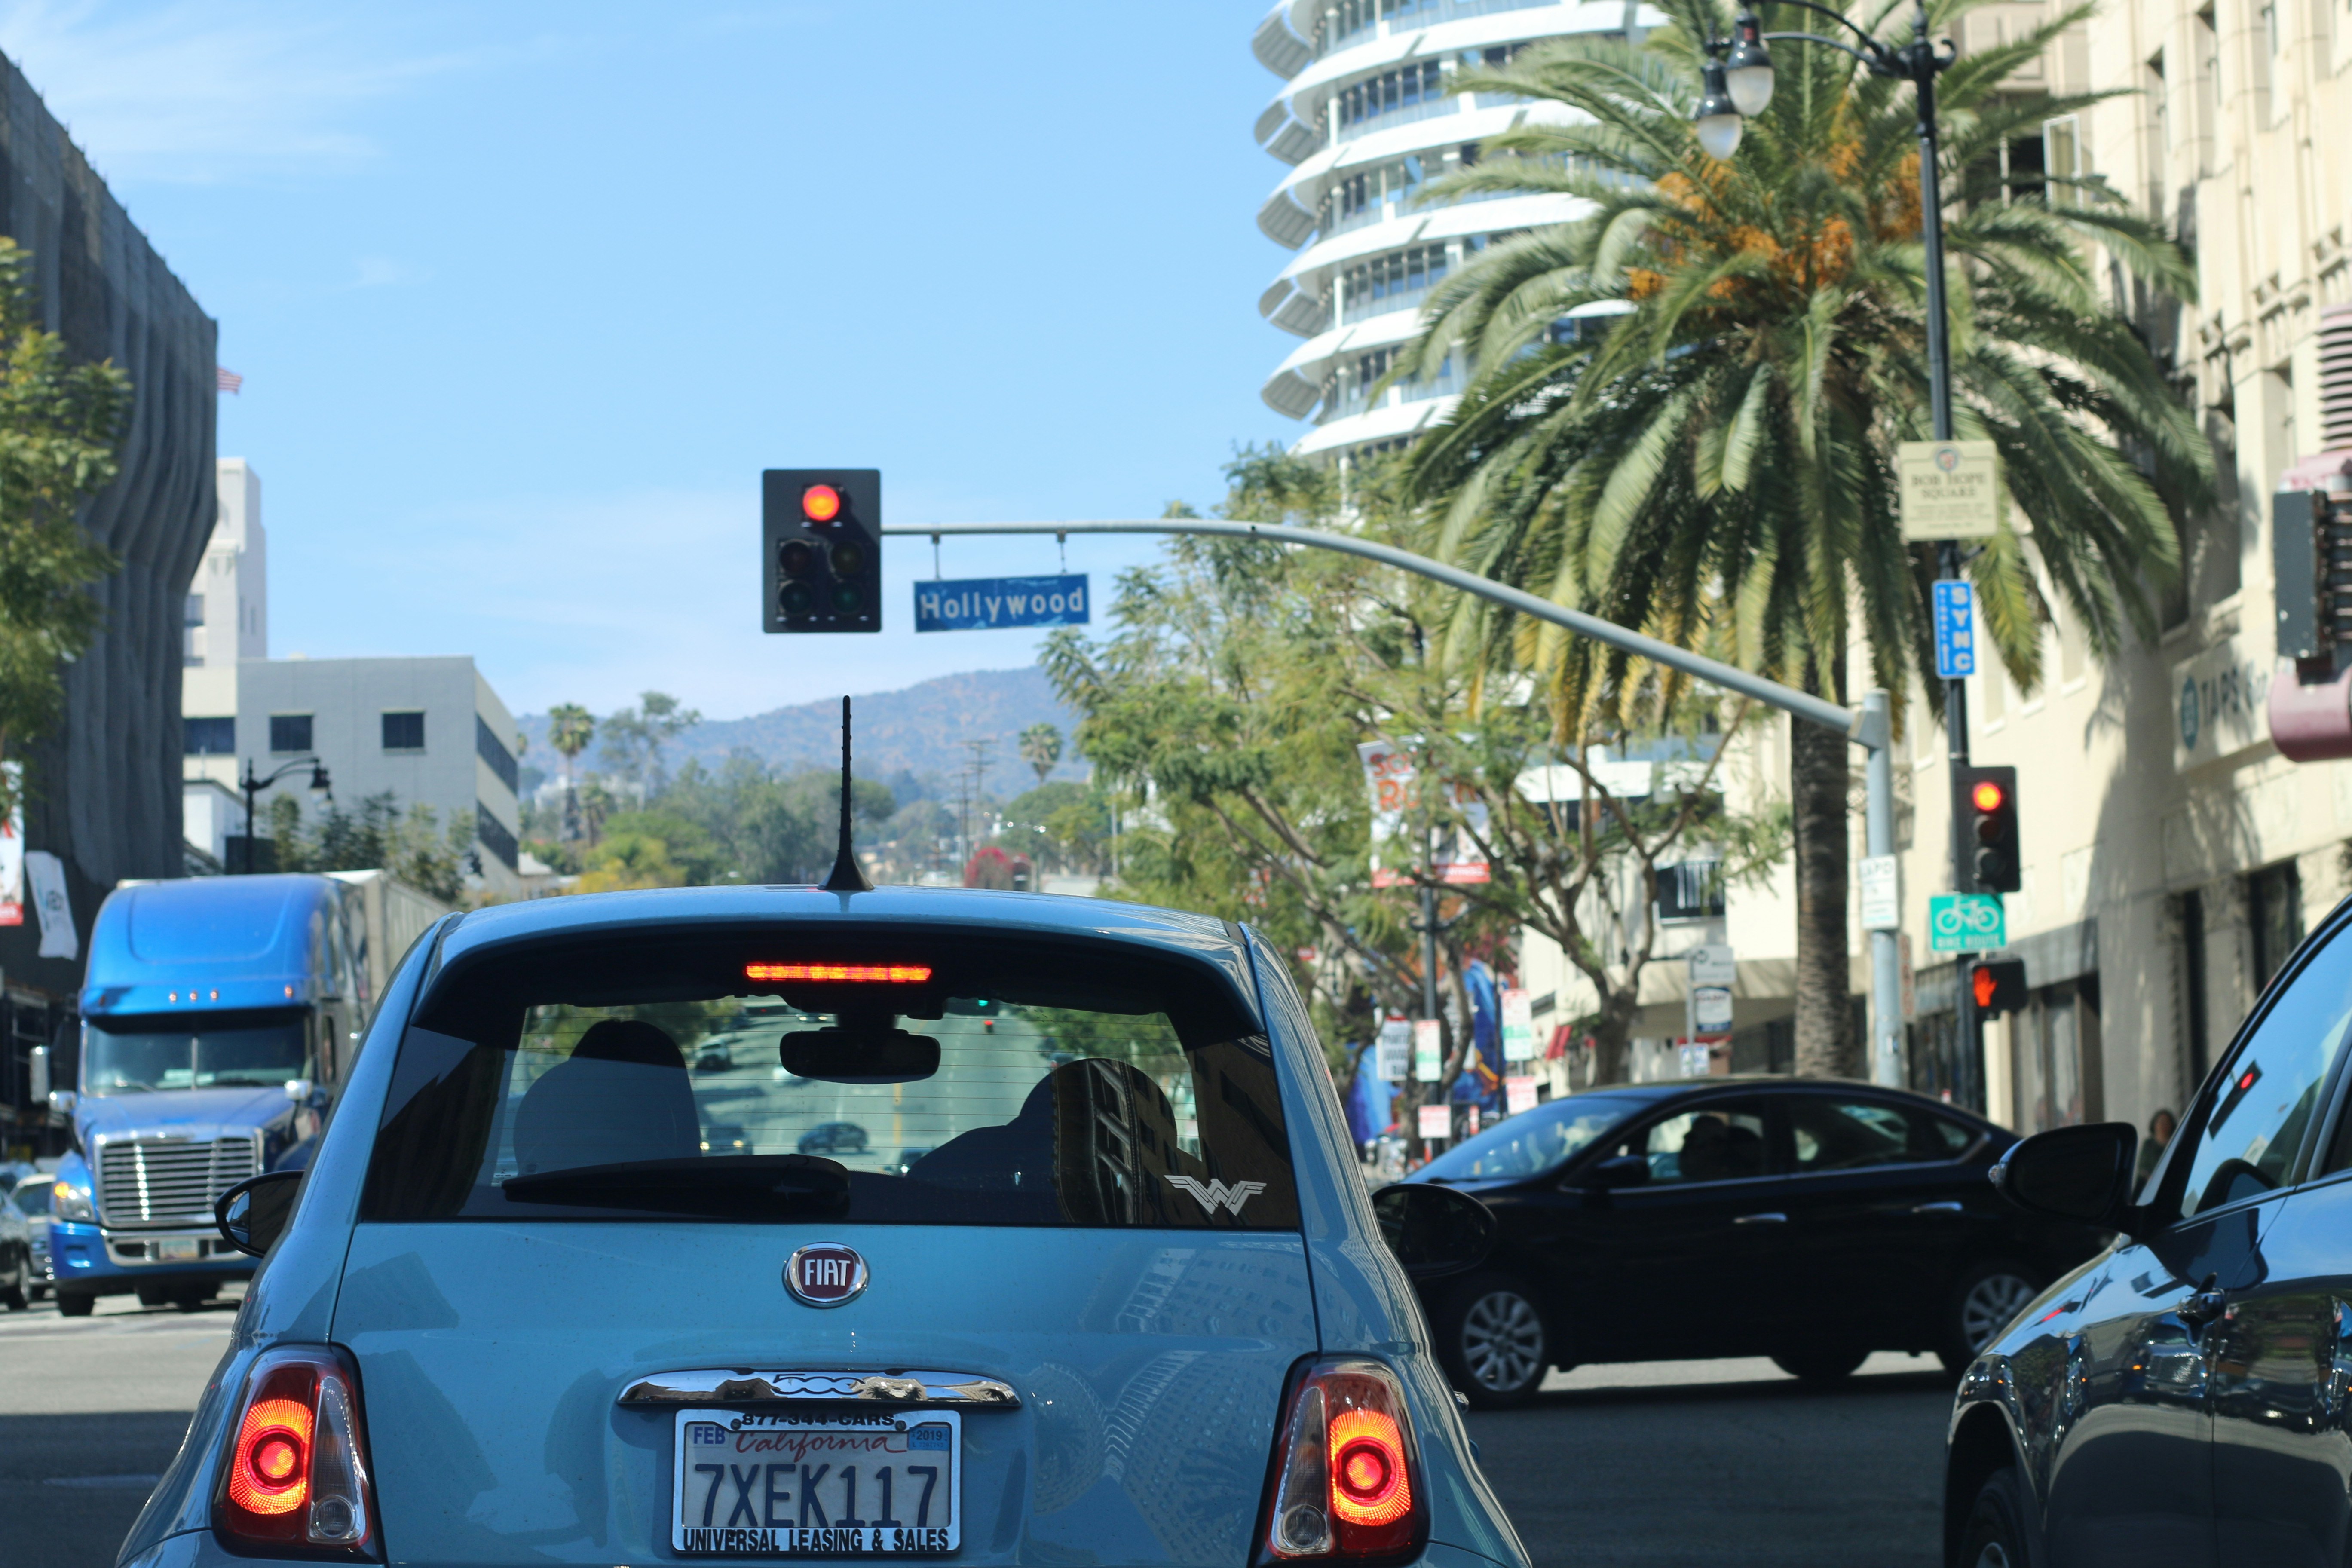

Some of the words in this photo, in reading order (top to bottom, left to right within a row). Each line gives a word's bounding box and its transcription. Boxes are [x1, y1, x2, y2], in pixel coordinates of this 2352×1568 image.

[1912, 474, 1940, 486] BOB
[1948, 473, 1985, 485] HOPE
[1921, 487, 1976, 499] SQUARE
[919, 586, 1084, 623] Hollywood
[1951, 586, 1971, 671] SYNC
[805, 1259, 851, 1286] FIAT
[742, 1413, 895, 1426] 877-344-CARS
[694, 1427, 726, 1445] FEB
[916, 1430, 943, 1441] 2019
[735, 1432, 907, 1463] California
[695, 1464, 937, 1528] 7XEK117
[683, 1528, 780, 1551] UNIVERSAL
[789, 1528, 863, 1551] LEASING
[873, 1528, 884, 1551] &
[894, 1528, 949, 1551] SALES
